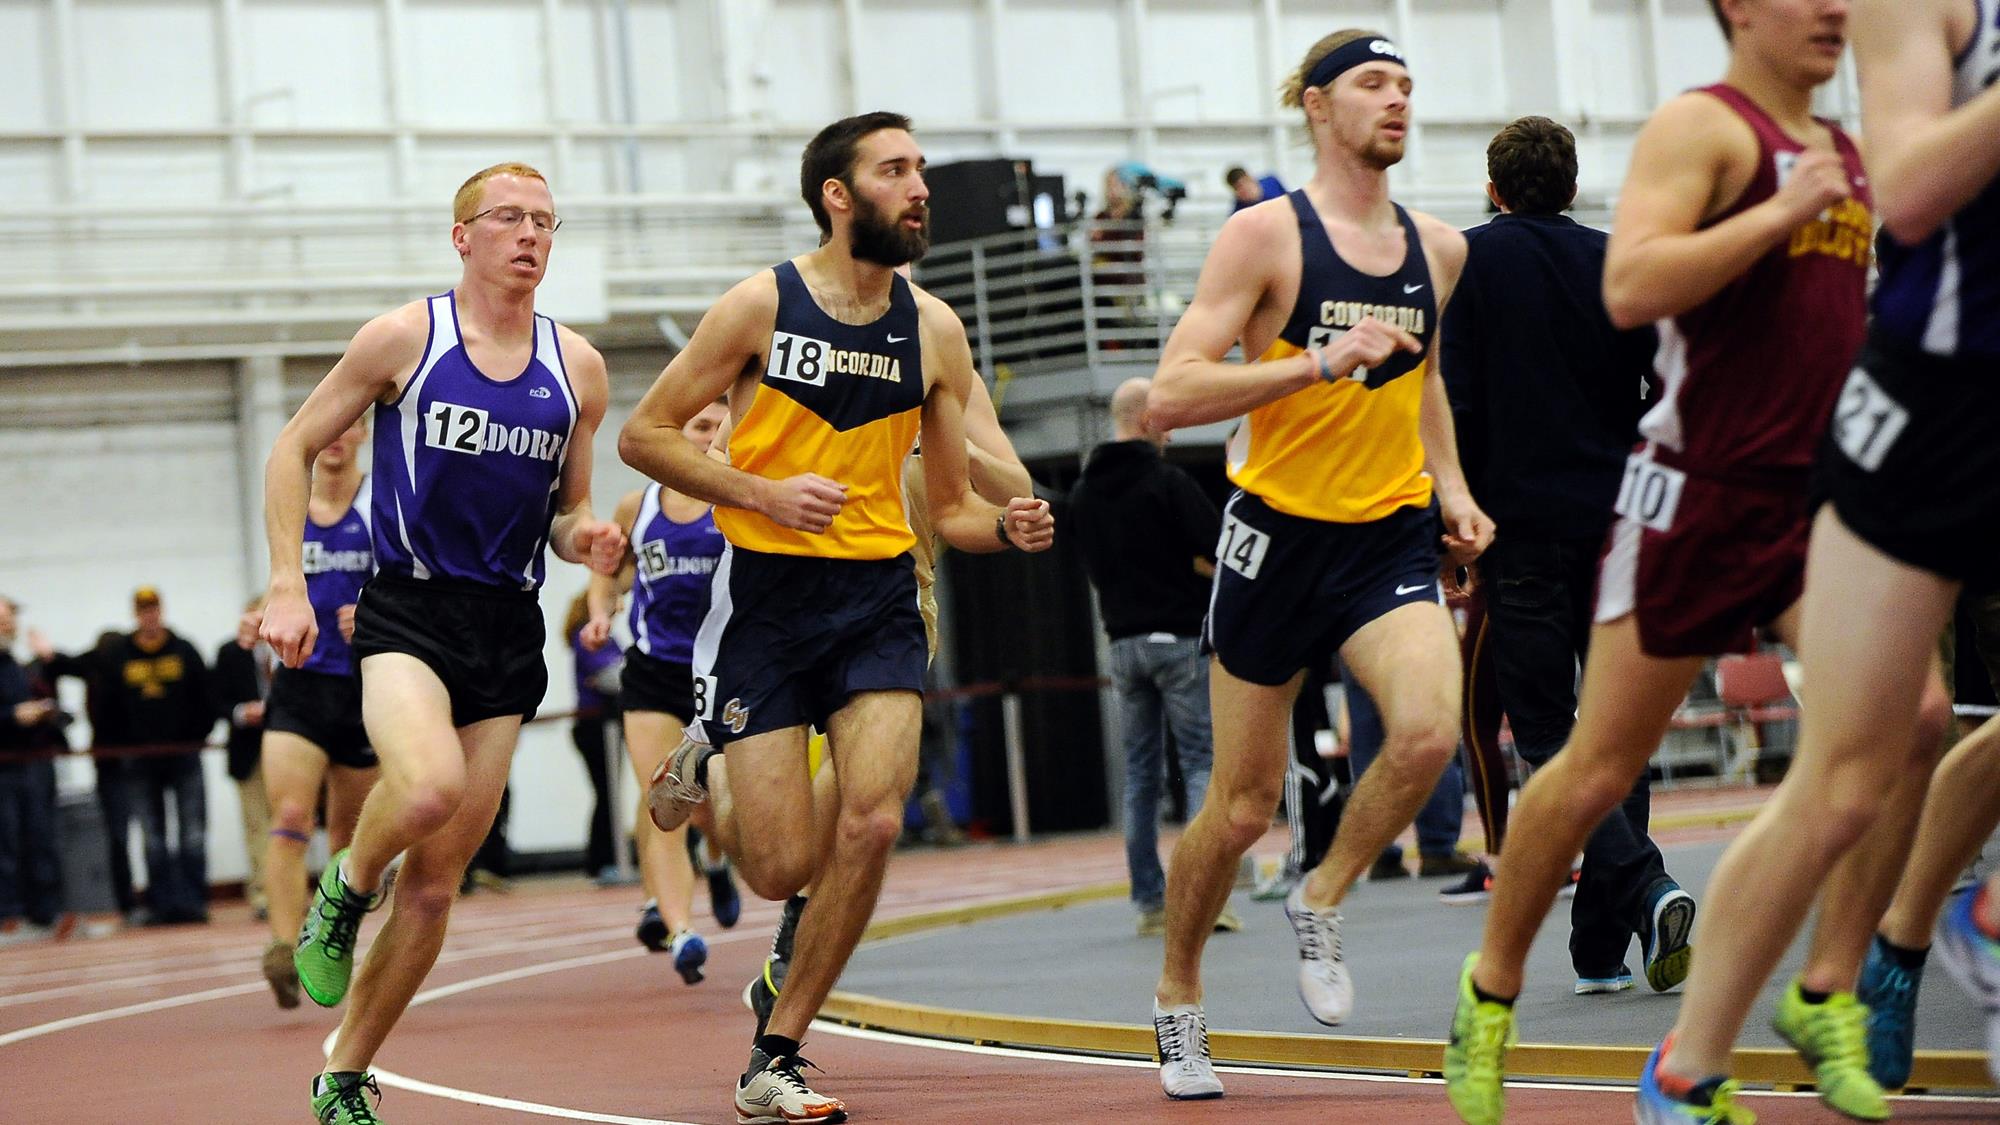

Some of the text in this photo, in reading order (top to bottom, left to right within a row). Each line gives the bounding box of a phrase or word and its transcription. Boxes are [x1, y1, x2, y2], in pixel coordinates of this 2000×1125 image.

[777, 336, 822, 381] 18
[435, 406, 480, 451] 12
[482, 422, 563, 461] DORF
[1625, 463, 1668, 521] 10
[643, 544, 665, 573] 15
[1223, 523, 1258, 573] 14
[695, 676, 707, 717] 8
